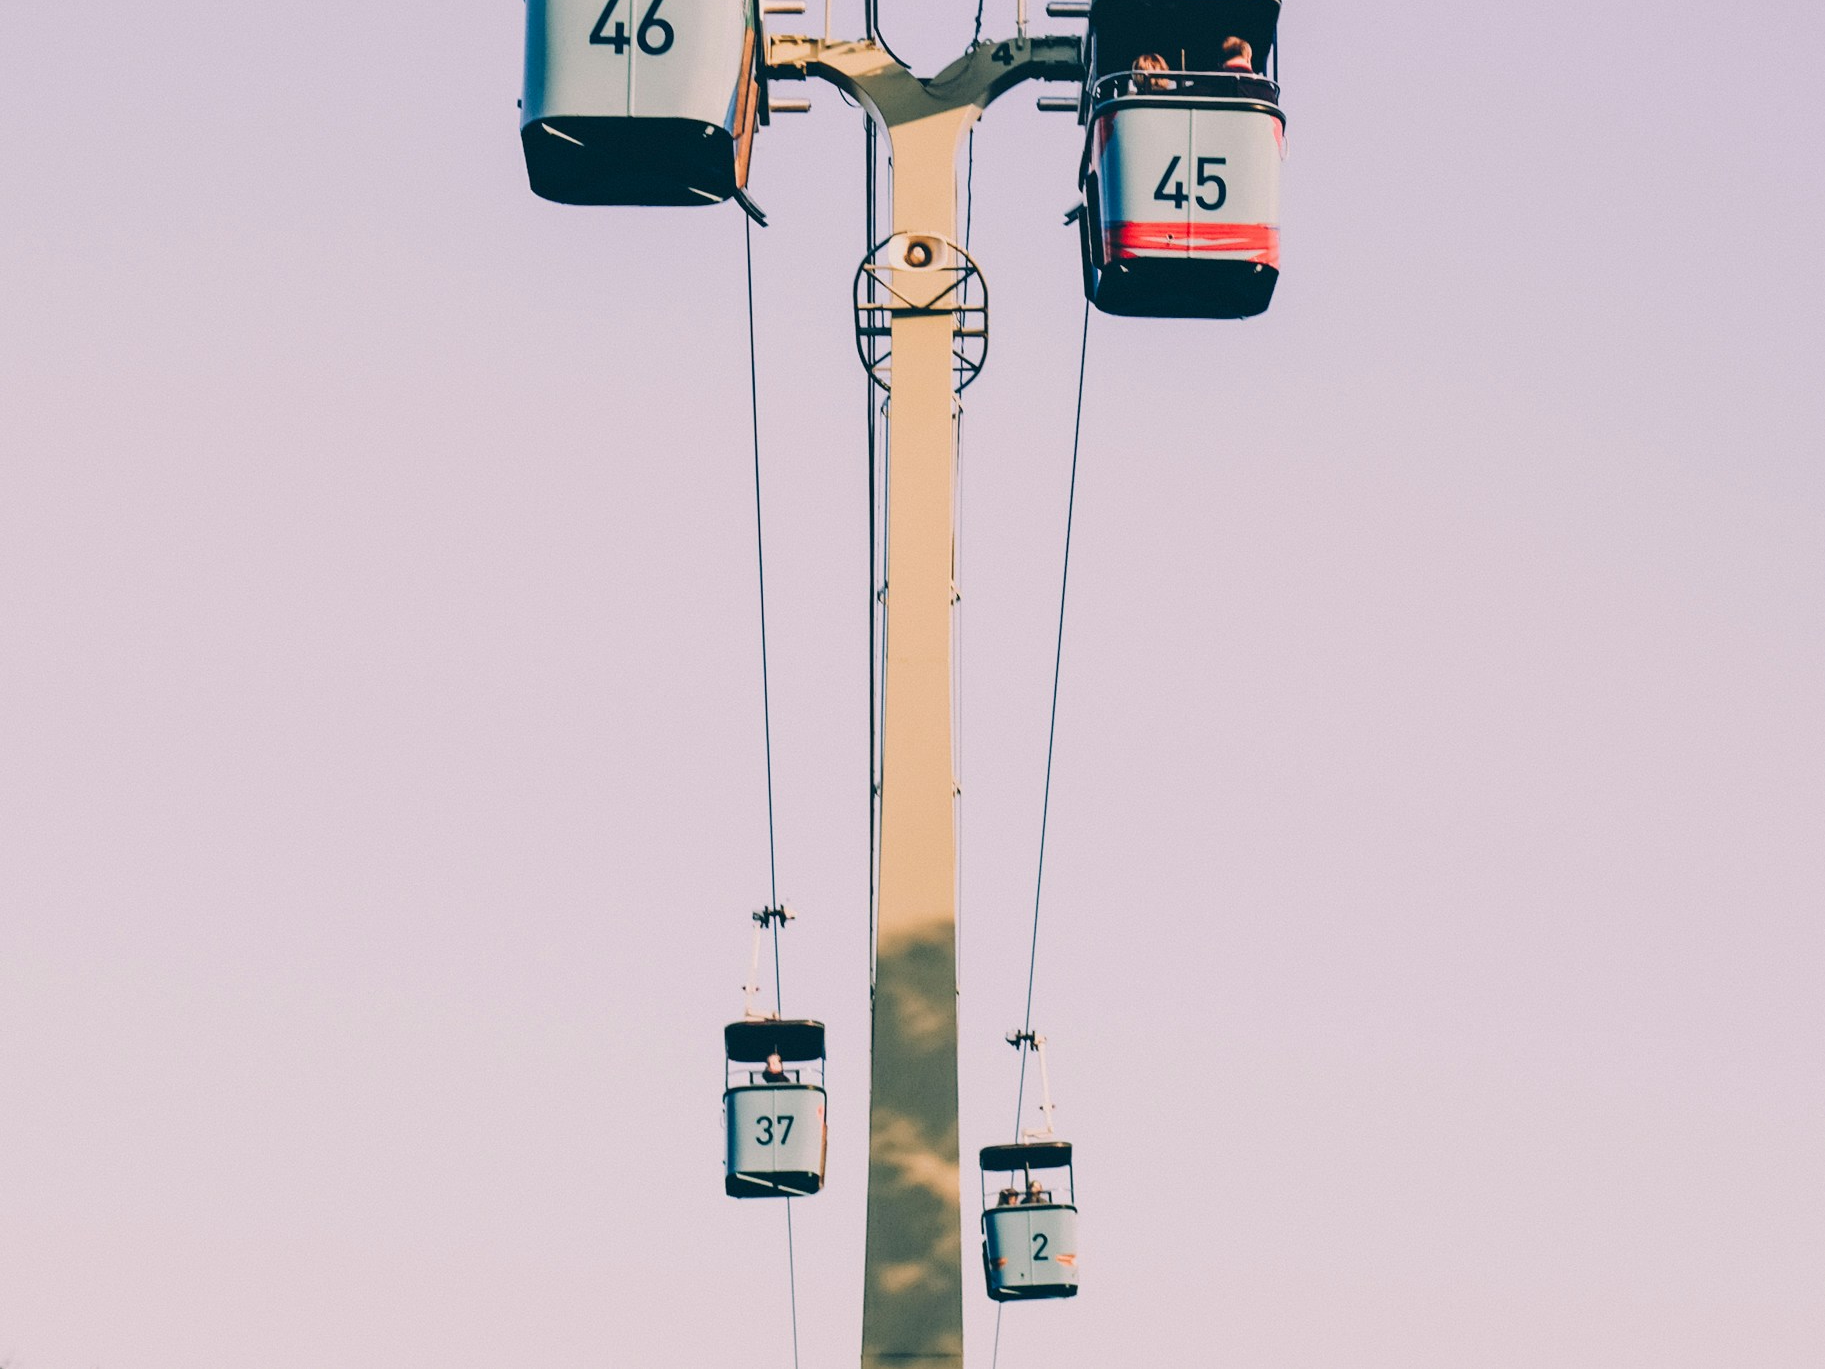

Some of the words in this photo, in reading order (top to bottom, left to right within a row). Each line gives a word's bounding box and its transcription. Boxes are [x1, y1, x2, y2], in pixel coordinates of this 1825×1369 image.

[990, 41, 1015, 67] 4
[1153, 155, 1227, 211] 45
[755, 1115, 795, 1146] 37
[1031, 1232, 1050, 1262] 2
